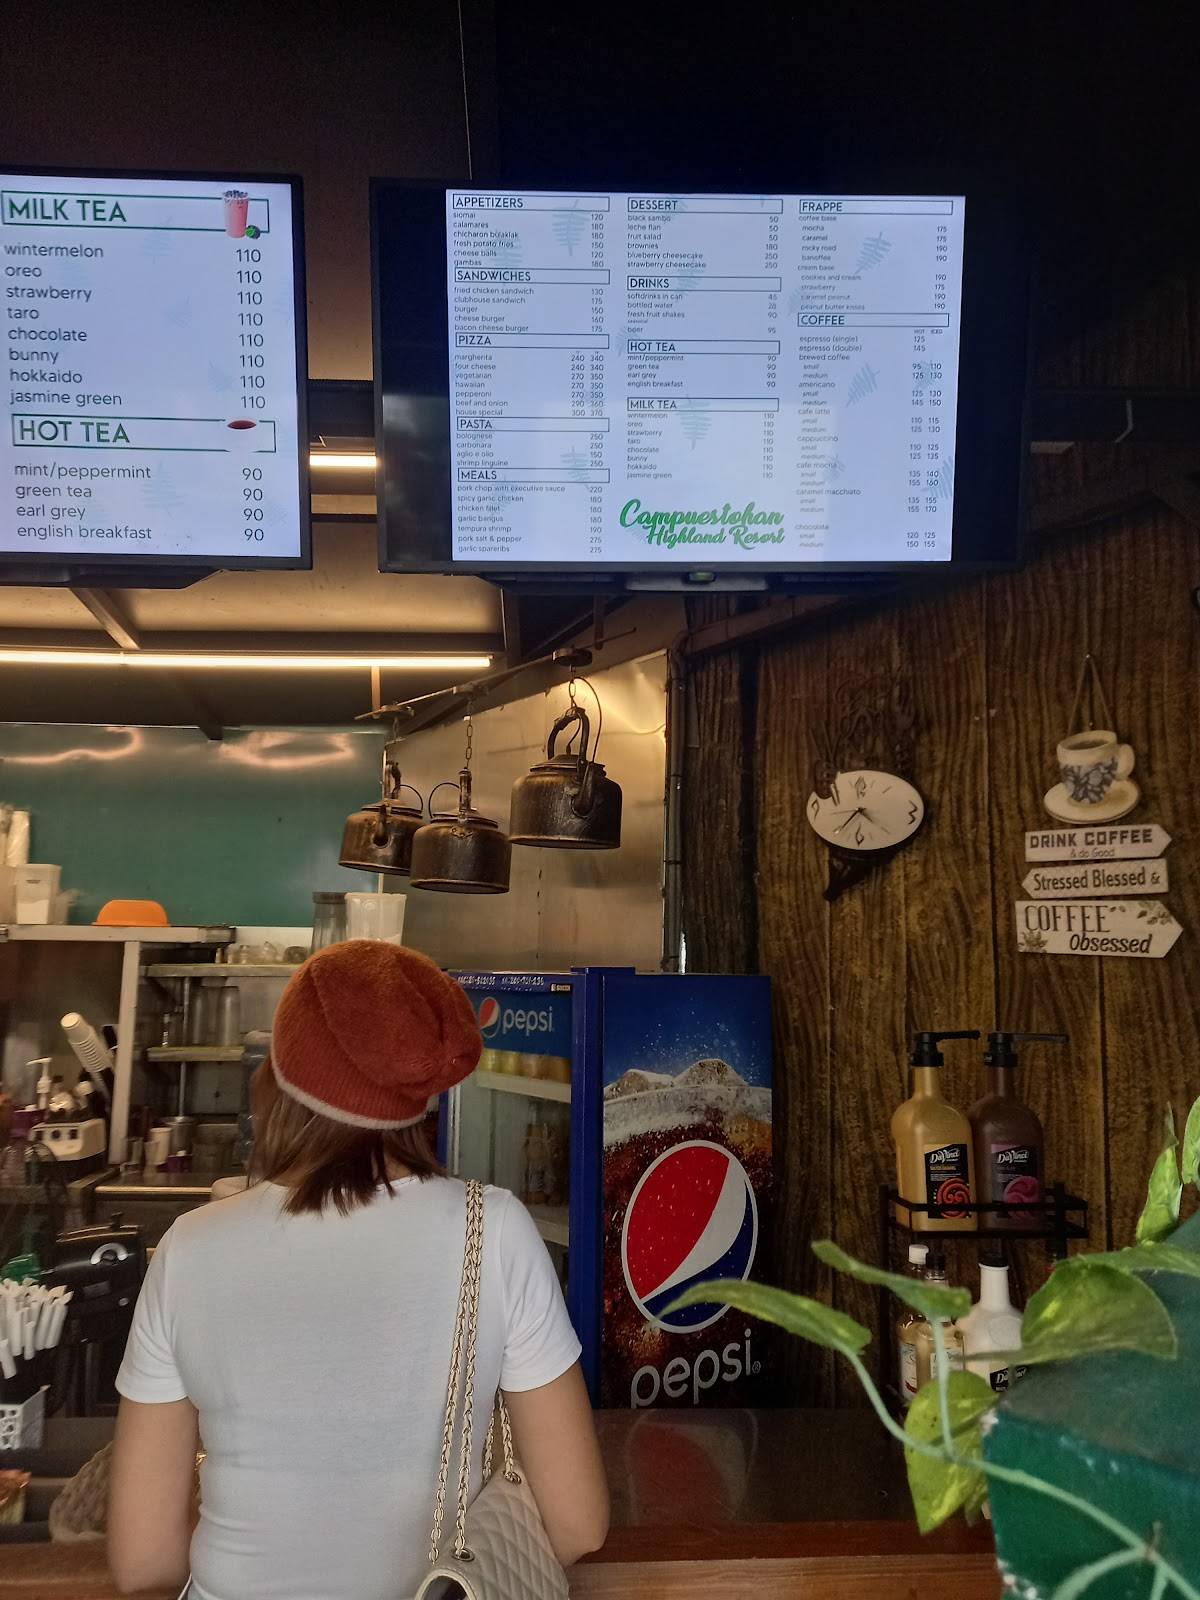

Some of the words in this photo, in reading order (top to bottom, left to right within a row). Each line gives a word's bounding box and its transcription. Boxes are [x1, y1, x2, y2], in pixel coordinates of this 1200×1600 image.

[9, 198, 69, 220] MILK
[78, 200, 126, 222] TEA
[456, 197, 523, 208] APPETIZERS
[631, 200, 677, 210] DESSERT
[802, 202, 842, 211] FRAPPE
[5, 244, 104, 258] wintermelon
[236, 249, 260, 262] 110
[454, 259, 481, 267] gambas
[6, 266, 42, 278] oreo
[237, 270, 262, 284] 110
[458, 271, 531, 281] SANDWICHES
[630, 279, 669, 288] DRINKS
[6, 286, 92, 302] strawberry
[237, 292, 262, 304] 110
[8, 307, 39, 320] taro
[238, 312, 262, 326] 110
[801, 315, 844, 324] COFFEE
[8, 328, 87, 342] chocolate
[239, 334, 264, 347] 110
[458, 336, 492, 345] PIZZA
[833, 335, 857, 343] (single)
[630, 342, 652, 351] HOT
[657, 342, 676, 351] TEA
[9, 348, 58, 364] bunny
[240, 354, 264, 368] 110
[455, 354, 492, 362] margherita
[10, 369, 82, 383] hokkaido
[240, 376, 264, 388] 110
[10, 392, 70, 406] jasmine
[76, 394, 122, 407] green
[240, 396, 265, 408] 110
[630, 400, 655, 409] MILK
[657, 400, 676, 409] TEA
[20, 420, 72, 441] HOT
[80, 422, 130, 442] TEA
[460, 420, 492, 429] PASTA
[14, 462, 150, 480] mint/peppermint
[242, 468, 262, 480] 90
[461, 471, 497, 479] MEALS
[16, 486, 61, 498] green
[67, 486, 92, 498] tea
[244, 488, 262, 501] 90
[16, 504, 44, 516] earl
[51, 506, 85, 520] grey
[244, 508, 263, 521] 90
[620, 499, 784, 533] Campuestohan
[18, 524, 72, 540] english
[79, 525, 152, 539] breakfast
[244, 528, 264, 541] 90
[642, 526, 726, 549] Highland
[729, 525, 785, 550] Resort
[1030, 832, 1077, 848] DRINK
[1085, 829, 1152, 846] COFFEE
[1071, 850, 1076, 858] &
[1079, 850, 1089, 858] do
[1092, 848, 1115, 857] Good
[1034, 871, 1087, 891] Stressed
[1092, 867, 1145, 887] Blessed
[1151, 872, 1160, 885] &
[1024, 905, 1110, 933] COFFEE
[1070, 934, 1153, 954] Obsessed
[502, 1006, 553, 1036] pepsi
[631, 1328, 752, 1409] pepsi
